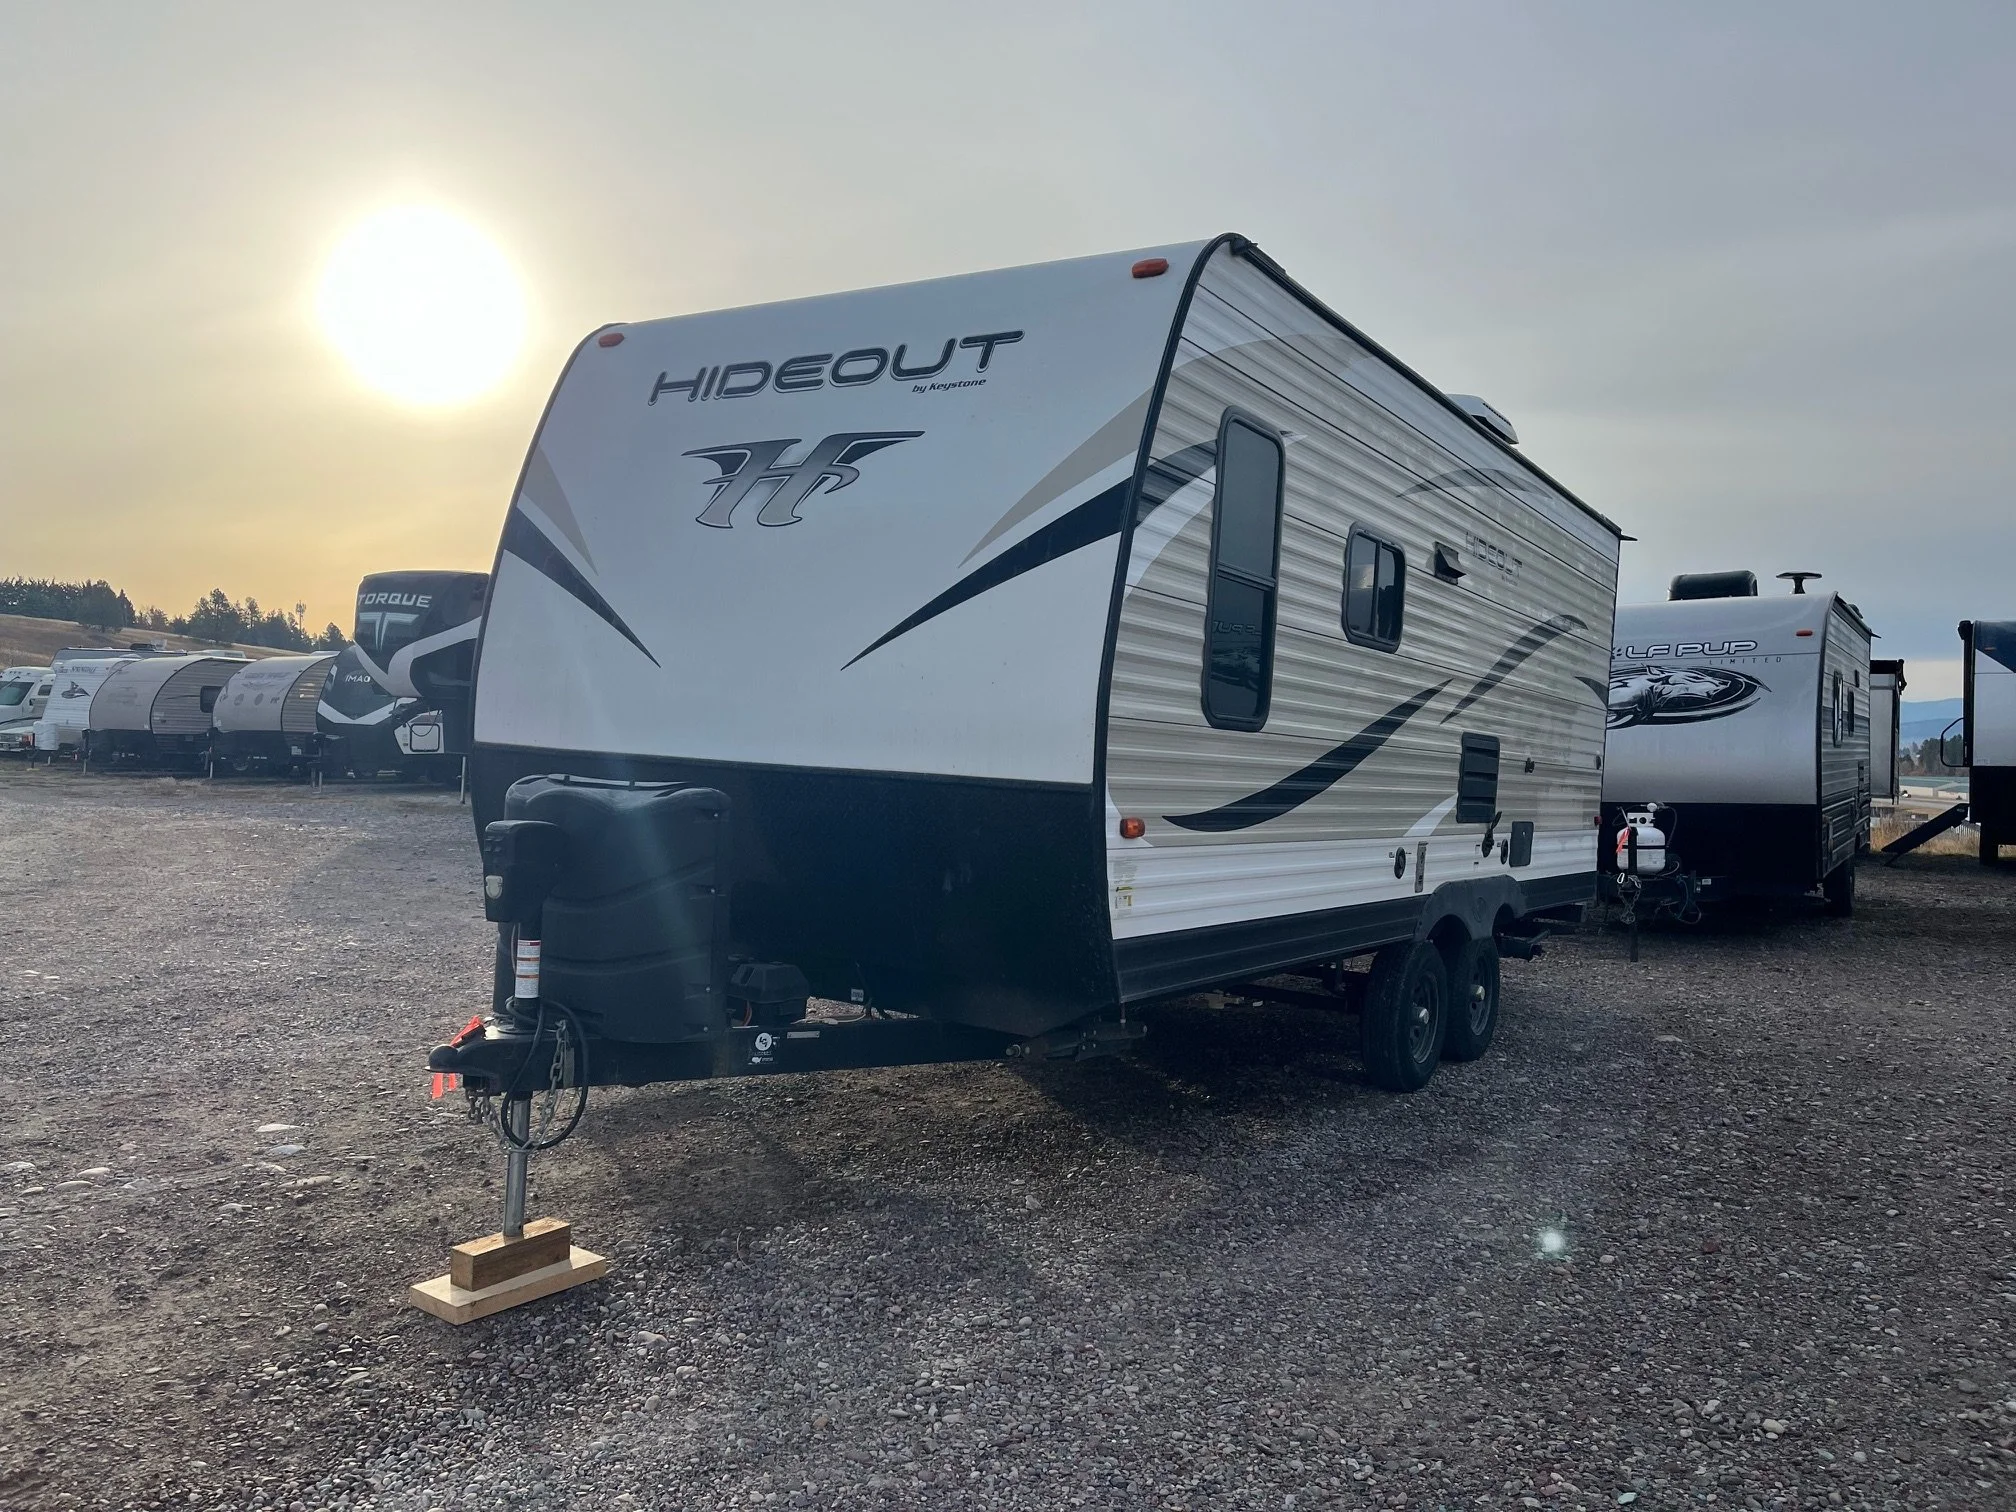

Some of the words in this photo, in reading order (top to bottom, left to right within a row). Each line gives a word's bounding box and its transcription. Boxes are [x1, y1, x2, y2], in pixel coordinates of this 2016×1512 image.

[648, 330, 1025, 405] HIDEOUT
[912, 385, 927, 394] by
[929, 379, 986, 391] Keystone
[358, 592, 432, 608] TORQUE
[1676, 640, 1758, 658] PUP
[1709, 656, 1782, 666] LIMITED
